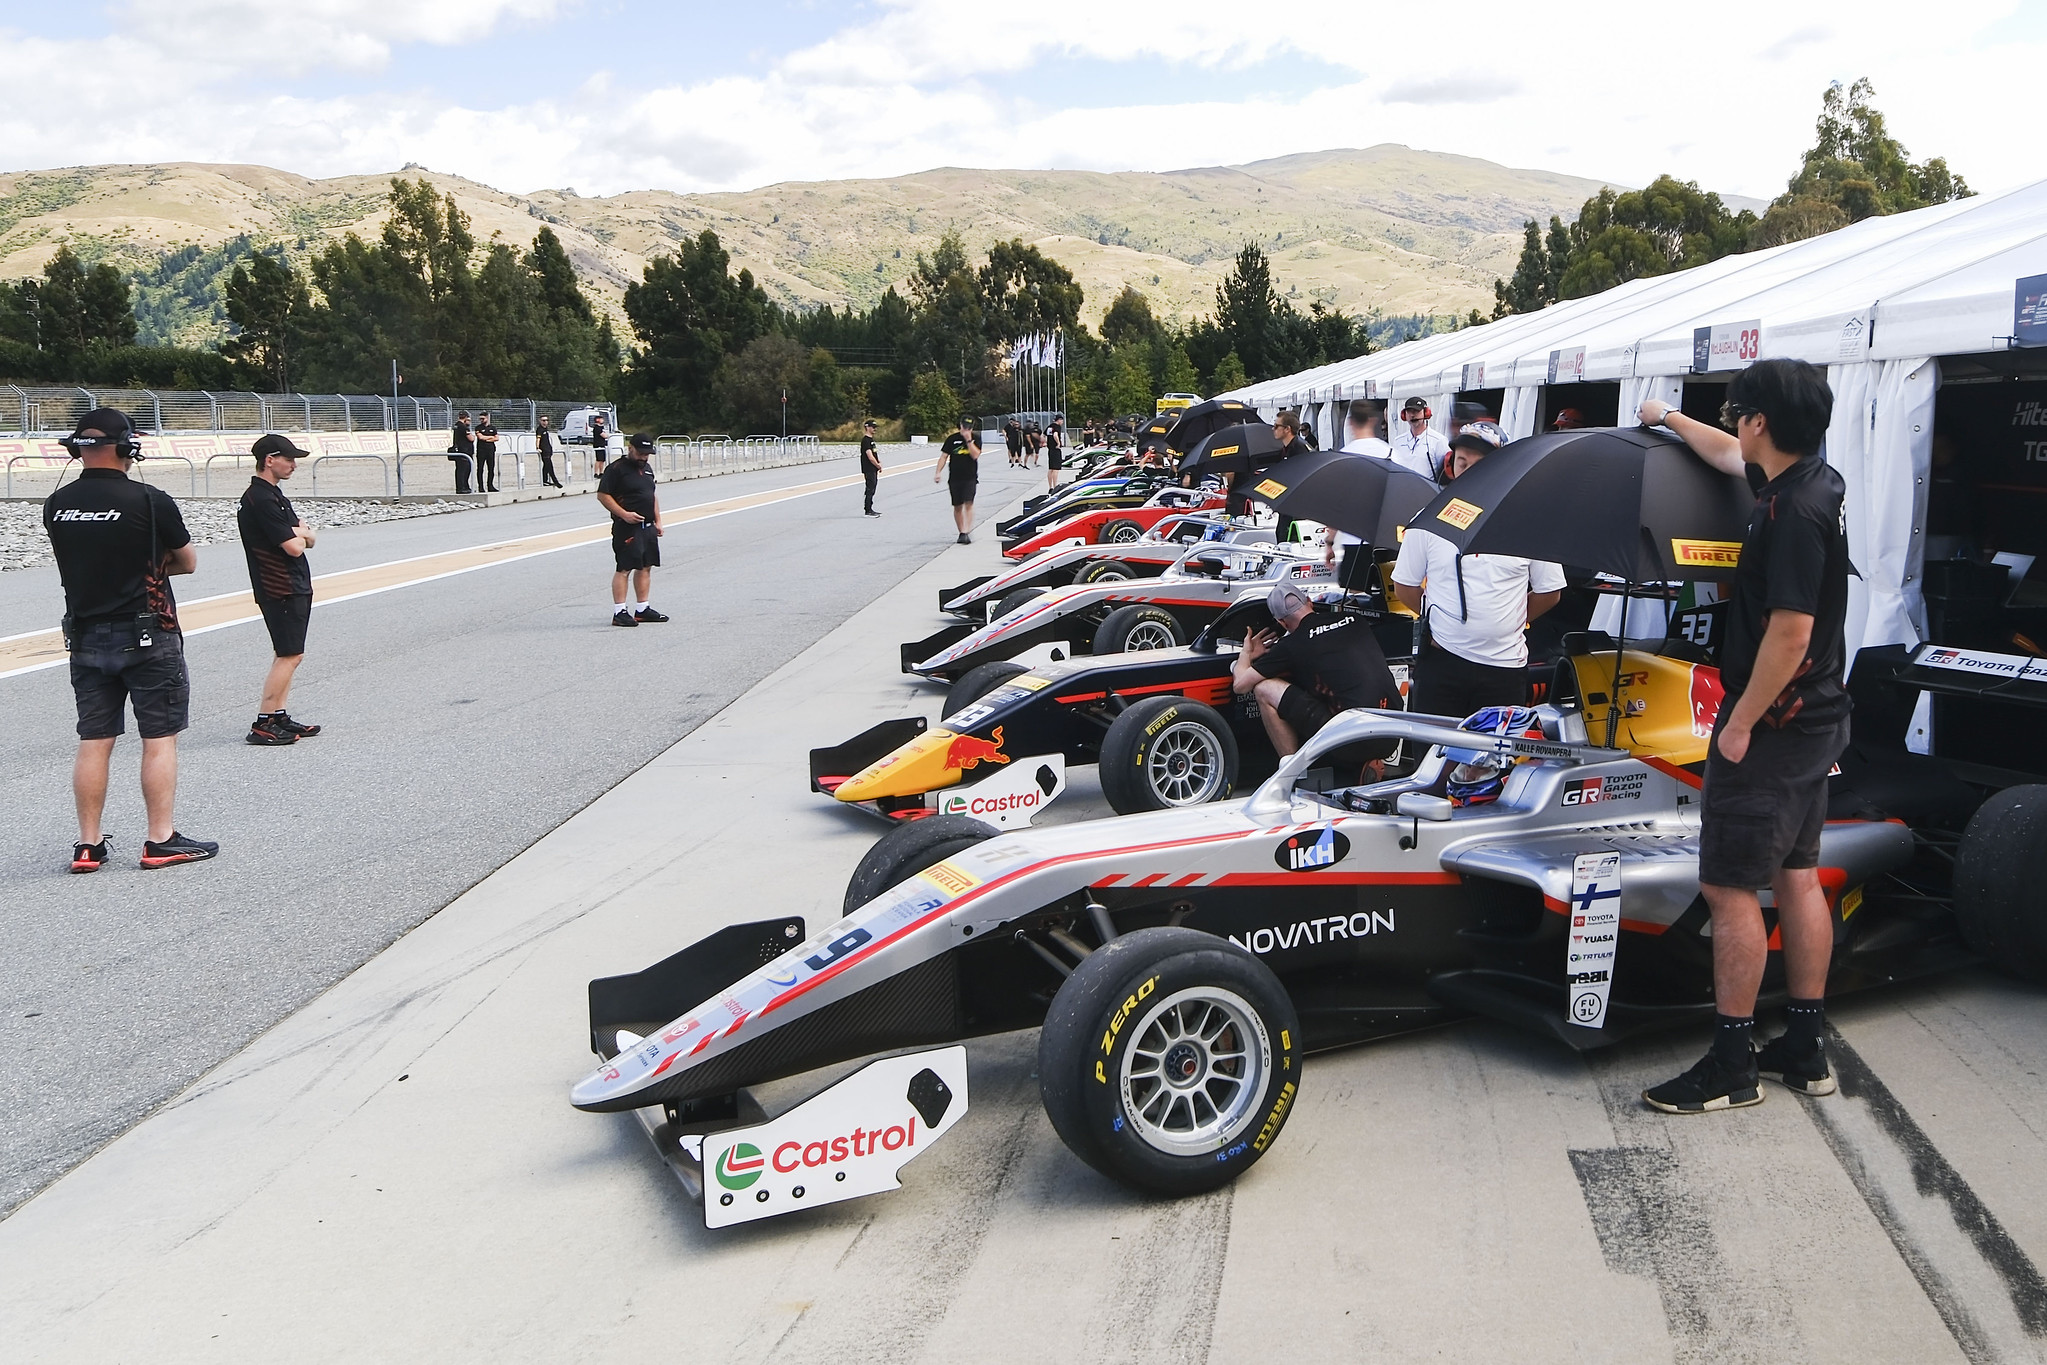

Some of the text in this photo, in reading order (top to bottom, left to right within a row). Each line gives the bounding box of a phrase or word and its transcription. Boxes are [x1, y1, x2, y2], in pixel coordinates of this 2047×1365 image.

[1740, 329, 1759, 359] 33
[1574, 352, 1584, 374] 12
[170, 439, 219, 461] PIRELLI
[358, 434, 389, 452] PIRELLI
[53, 509, 121, 522] Hitech
[1443, 503, 1476, 525] PIRELLI
[1680, 544, 1741, 562] PIREL
[1290, 570, 1311, 580] GR
[1309, 615, 1355, 639] Hitech
[1682, 613, 1713, 645] 33
[1958, 657, 2016, 672] TOYOTA
[1144, 706, 1179, 737] PIRELLI
[1515, 742, 1536, 754] KALLE
[1604, 782, 1643, 793] GAZOO
[1605, 773, 1648, 784] TOYOTA
[971, 789, 1041, 815] Castrol
[1562, 787, 1600, 806] GR
[1602, 790, 1641, 801] Racing
[924, 863, 974, 893] PIRELLI
[1228, 908, 1395, 954] NOVATRON
[1584, 934, 1614, 944] YUASA
[1095, 977, 1155, 1084] P ZERO
[1253, 1081, 1296, 1152] PIRELLI
[771, 1116, 917, 1174] Castrol
